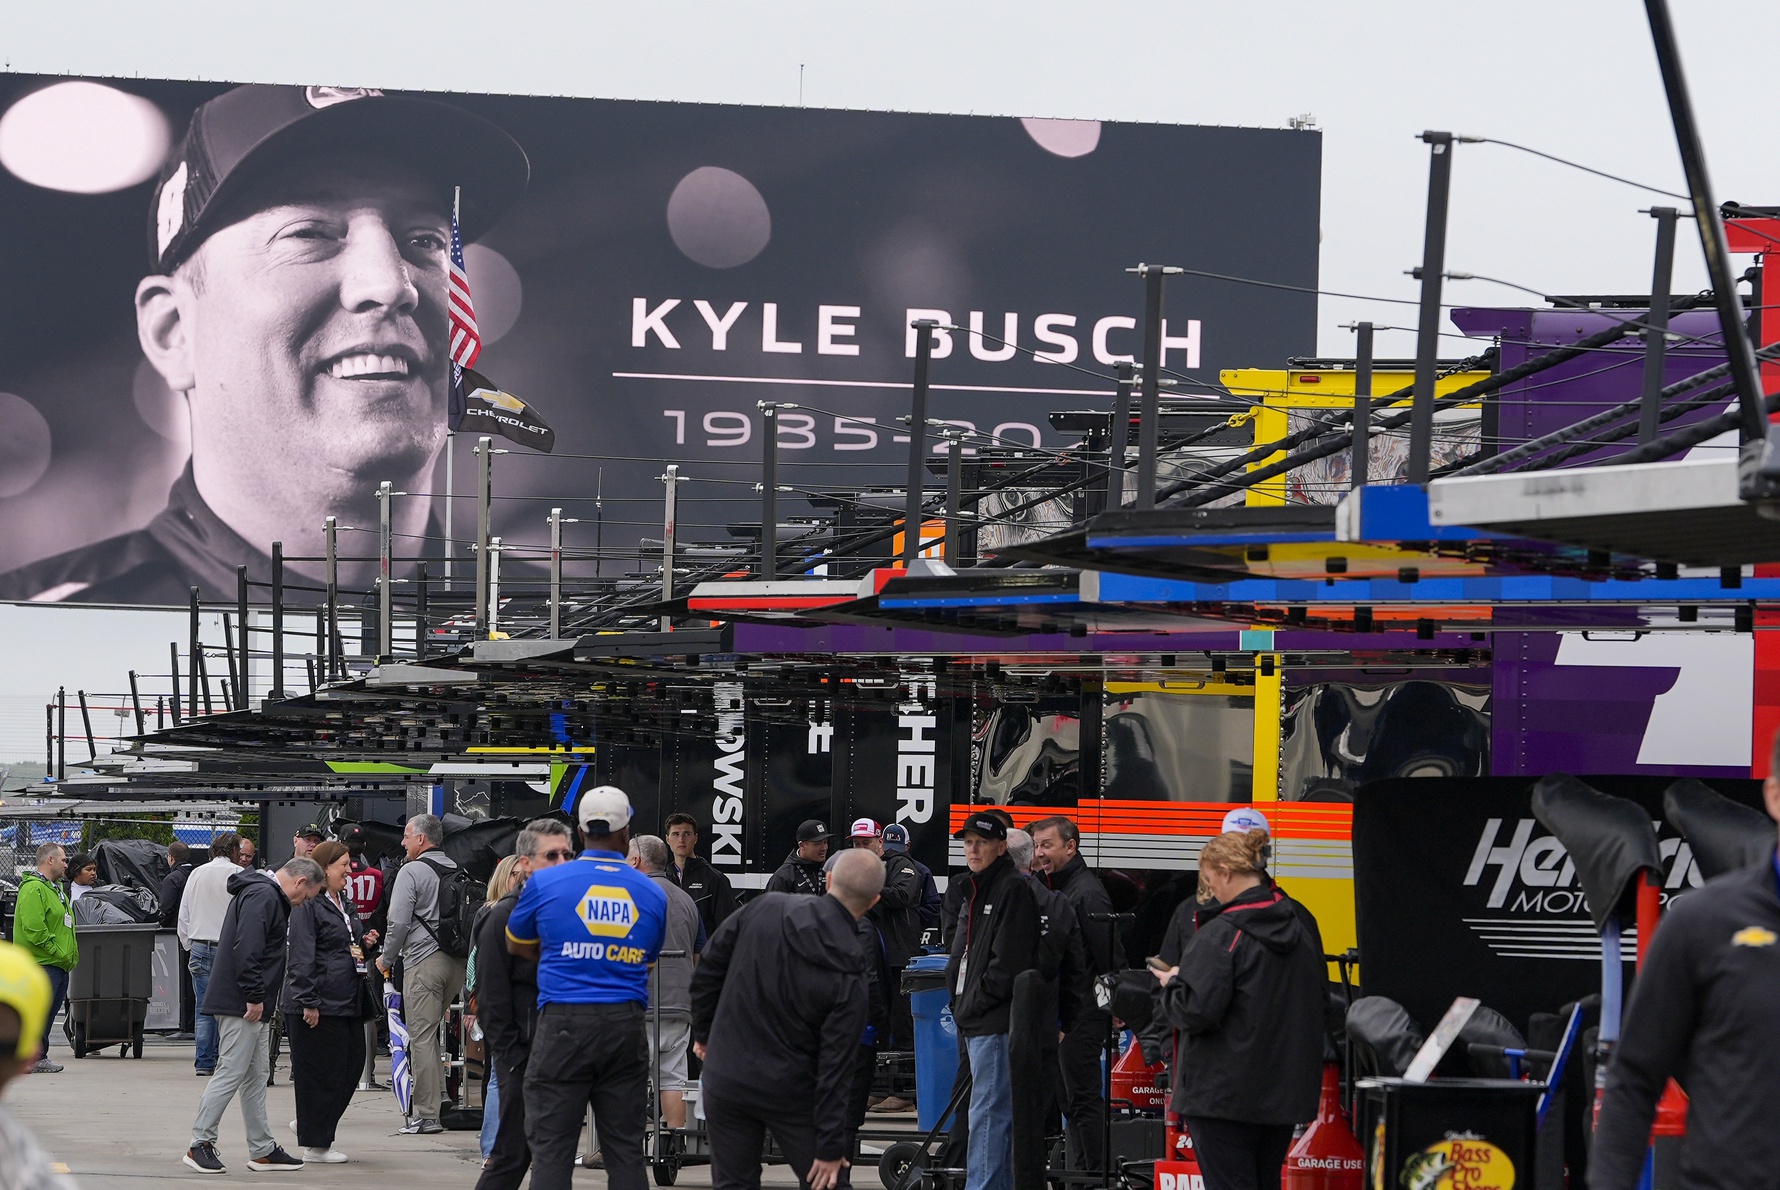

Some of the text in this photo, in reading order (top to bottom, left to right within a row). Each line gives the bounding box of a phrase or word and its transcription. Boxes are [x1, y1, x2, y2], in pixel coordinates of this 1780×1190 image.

[631, 298, 1202, 369] KYLE BUSCH
[588, 899, 630, 924] NAPA
[561, 941, 605, 960] AUTO
[1132, 1086, 1164, 1094] GARAGE
[1176, 1134, 1194, 1149] 24
[1449, 1143, 1491, 1163] Bass
[1297, 1157, 1341, 1169] GARAGE
[1343, 1159, 1363, 1170] USE
[1450, 1162, 1481, 1182] Pro
